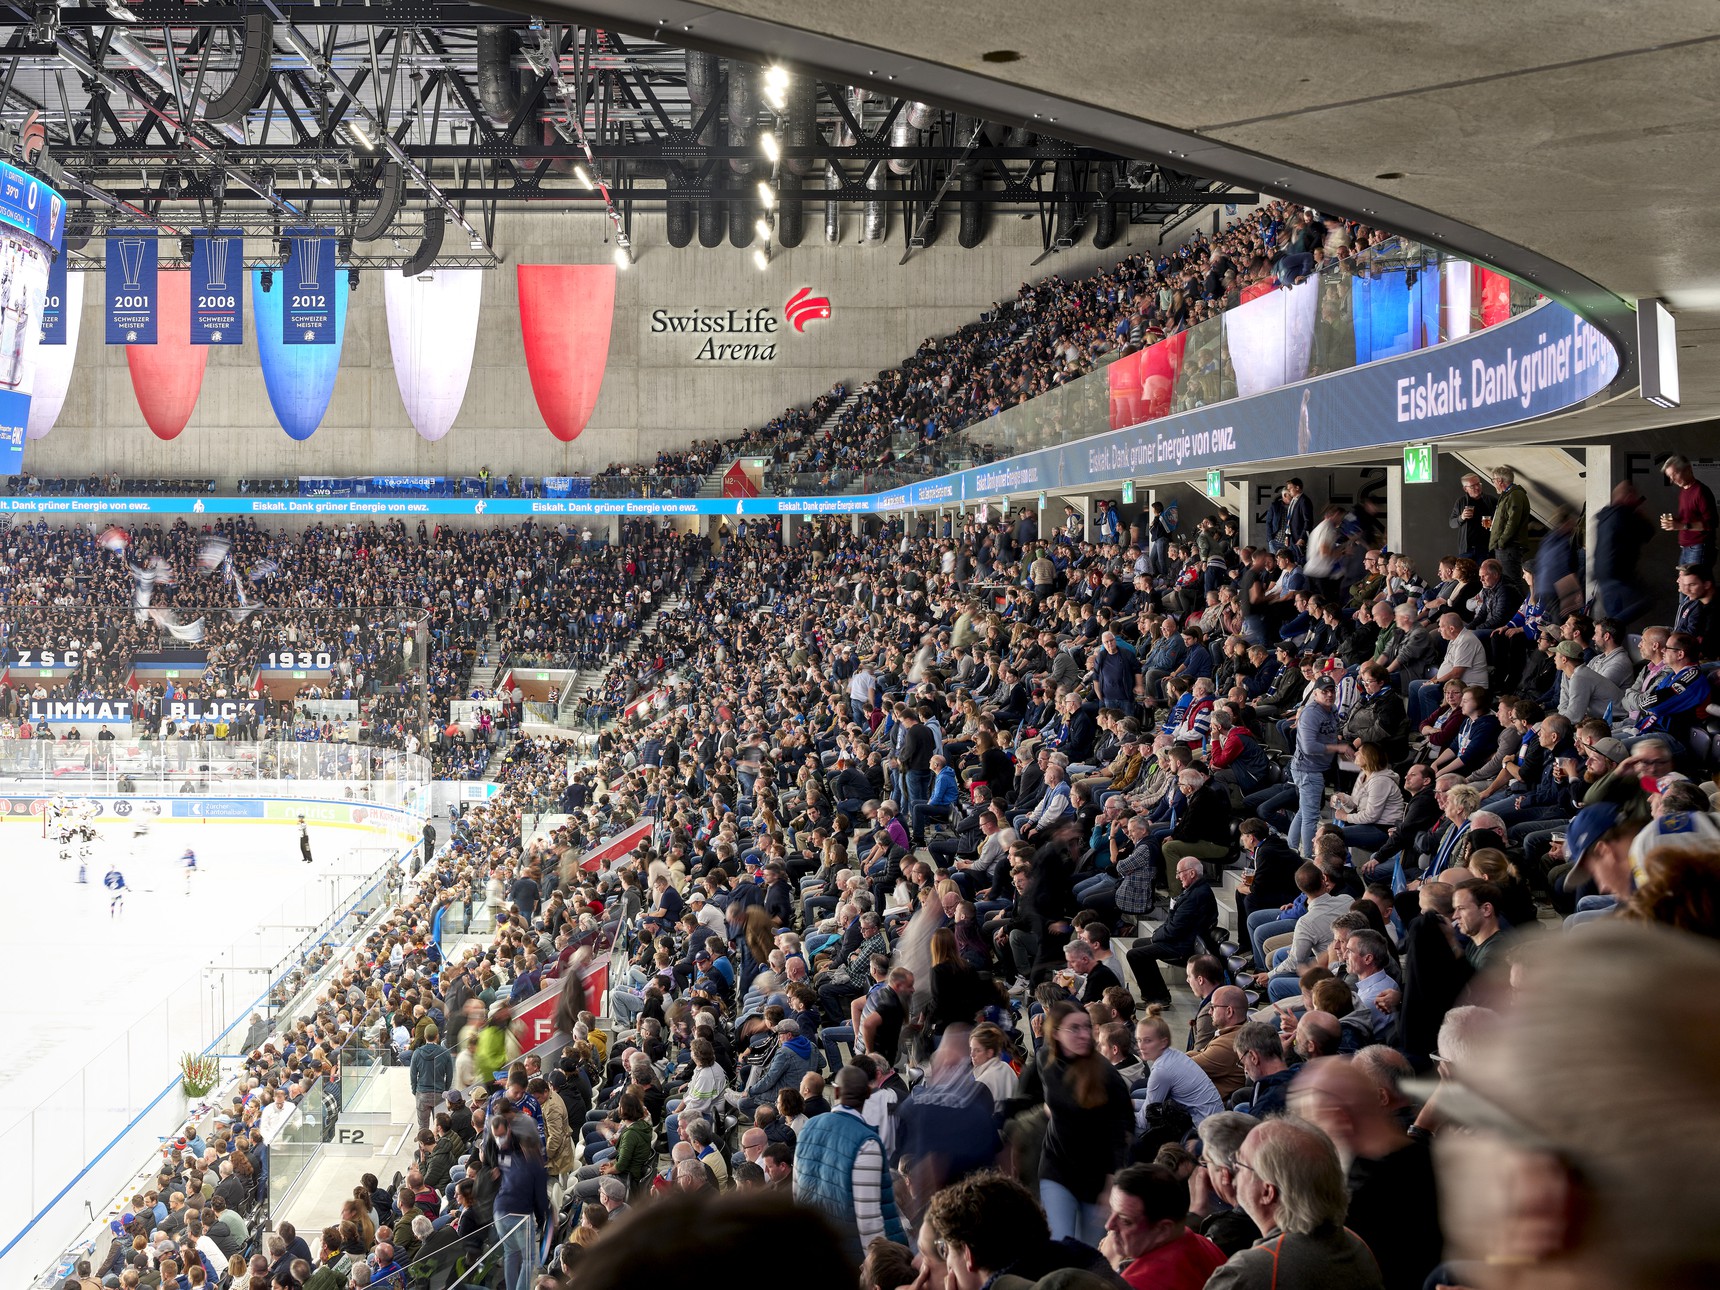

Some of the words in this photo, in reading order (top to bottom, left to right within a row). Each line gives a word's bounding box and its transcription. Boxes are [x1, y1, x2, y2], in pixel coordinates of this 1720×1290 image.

[28, 182, 38, 210] 0
[26, 218, 30, 228] 3
[114, 296, 148, 308] 2001
[198, 296, 235, 308] 2008
[292, 296, 326, 307] 2012
[651, 308, 778, 332] SwissLife
[695, 337, 777, 360] Arena
[1397, 366, 1467, 422] Eiskalt.
[1472, 348, 1517, 408] Dank
[1520, 332, 1572, 408] grüner
[1089, 446, 1111, 473] Eiskalt.
[1112, 442, 1129, 470] Dank
[1130, 438, 1156, 472] grüner
[1157, 429, 1190, 466] Energie
[1192, 431, 1210, 456] von
[1212, 426, 1236, 453] ewz.
[38, 502, 69, 512] grüner
[72, 502, 108, 512] Energie
[252, 502, 287, 510] Eiskalt.
[290, 502, 314, 510] Dank
[316, 502, 348, 512] grüner
[350, 502, 386, 512] Energie
[532, 503, 566, 511] Eiskalt.
[569, 503, 592, 511] Dank
[594, 503, 625, 512] grüner
[627, 503, 660, 512] Energie
[778, 502, 802, 511] Eiskalt.
[803, 502, 818, 510] Dank
[819, 502, 837, 512] grüner
[837, 501, 854, 512] Energie
[268, 652, 331, 668] 1930
[32, 702, 128, 719] LIMMAT
[115, 804, 130, 812] ISS
[285, 806, 335, 819] netrics
[339, 1129, 364, 1143] F2
